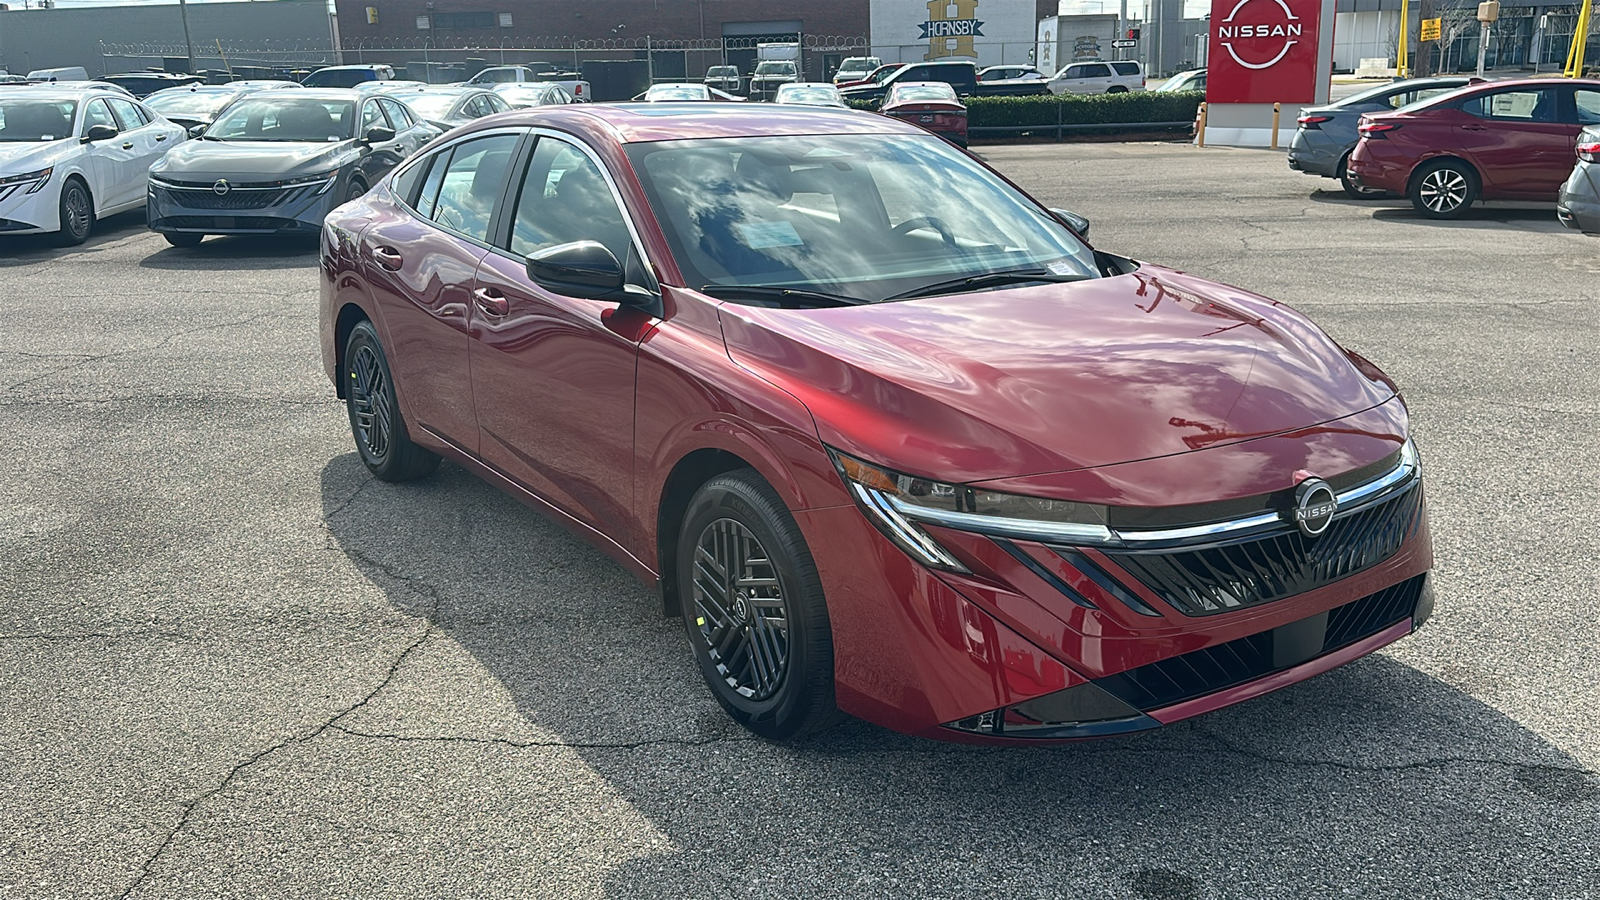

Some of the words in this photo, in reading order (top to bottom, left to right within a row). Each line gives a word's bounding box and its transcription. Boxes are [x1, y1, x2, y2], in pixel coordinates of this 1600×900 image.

[928, 20, 976, 37] HORNSBY
[1219, 23, 1302, 38] NISSAN
[1297, 502, 1338, 519] NISSAN
